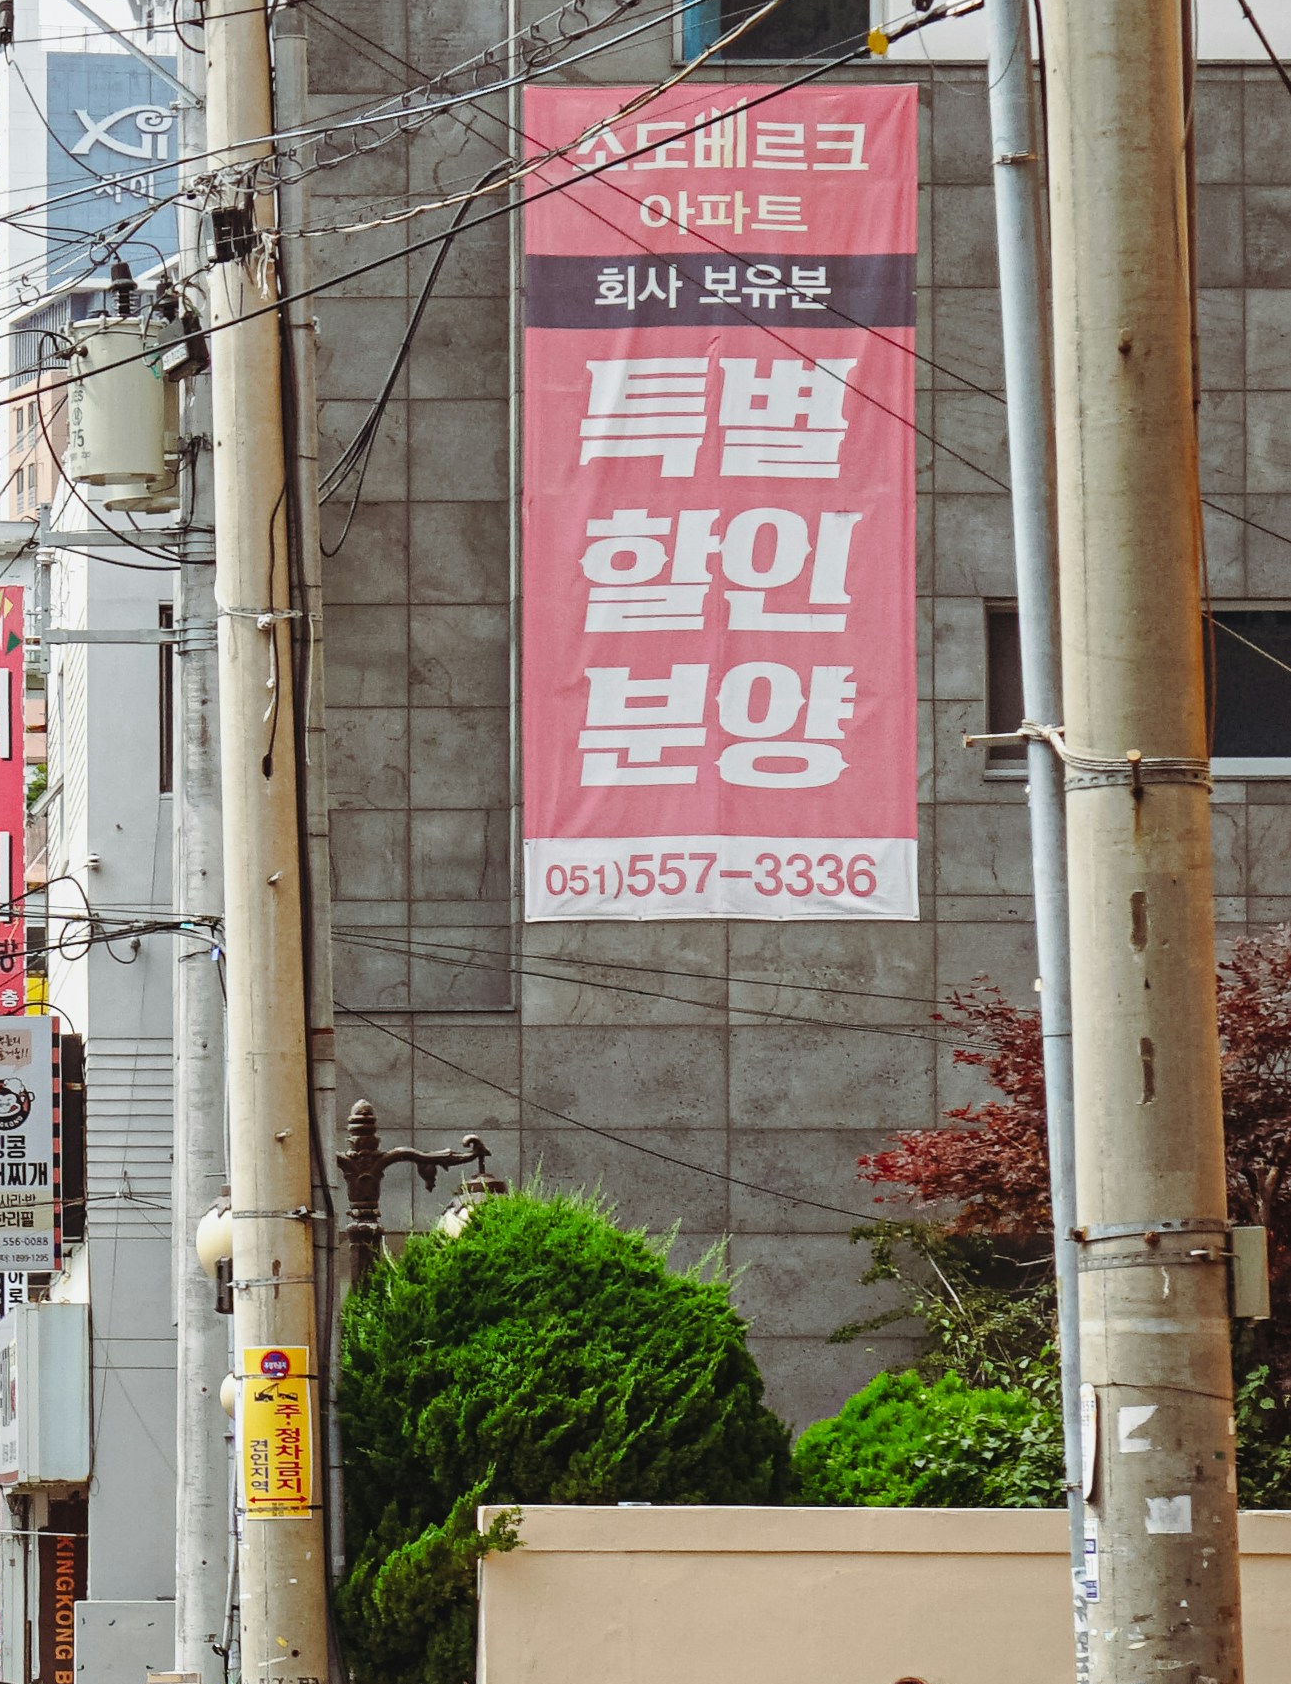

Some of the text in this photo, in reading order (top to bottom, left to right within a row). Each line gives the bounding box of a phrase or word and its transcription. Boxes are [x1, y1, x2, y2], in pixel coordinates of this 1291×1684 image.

[639, 191, 809, 235] 아파트
[594, 264, 832, 311] 회사 보유분
[579, 357, 858, 479] 특별
[578, 507, 863, 634] 할인
[577, 661, 858, 790] 분양
[545, 852, 878, 899] 051)557-3336
[250, 1438, 269, 1493] 견인지역
[55, 1536, 75, 1660] KINGKONG
